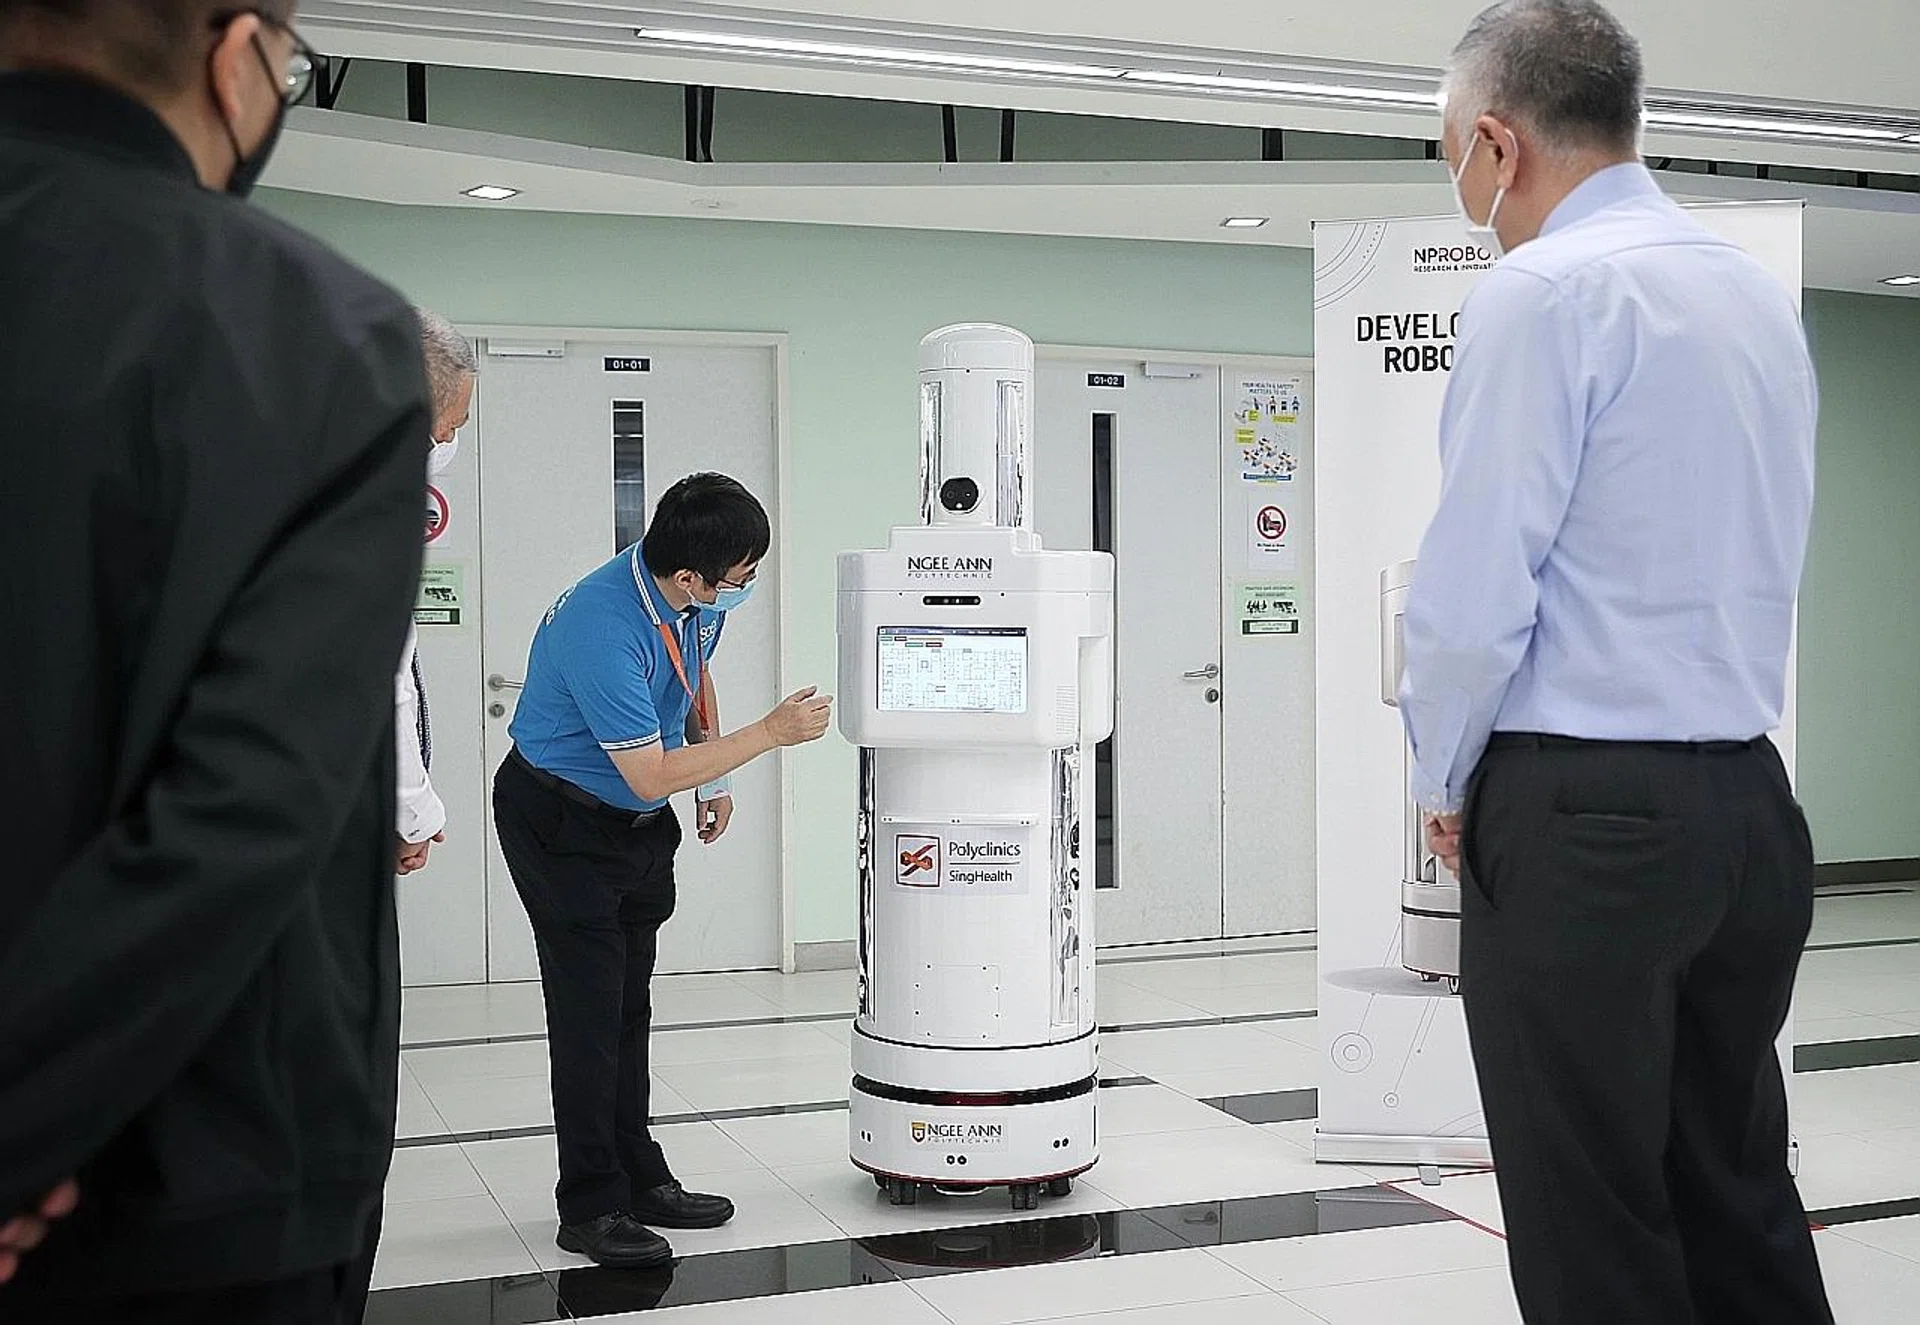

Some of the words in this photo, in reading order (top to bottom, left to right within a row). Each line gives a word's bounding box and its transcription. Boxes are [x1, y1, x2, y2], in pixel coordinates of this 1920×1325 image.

[1414, 246, 1498, 263] NPROBO
[1414, 264, 1452, 272] RESEARCH
[613, 359, 642, 369] 01-01
[1093, 376, 1119, 385] 01-02
[907, 556, 949, 570] NGEE
[954, 557, 992, 571] ANN
[949, 841, 1021, 860] Polyclinics
[949, 870, 1012, 884] SingHealth
[928, 1123, 964, 1137] NGEE
[967, 1124, 1002, 1137] ANN
